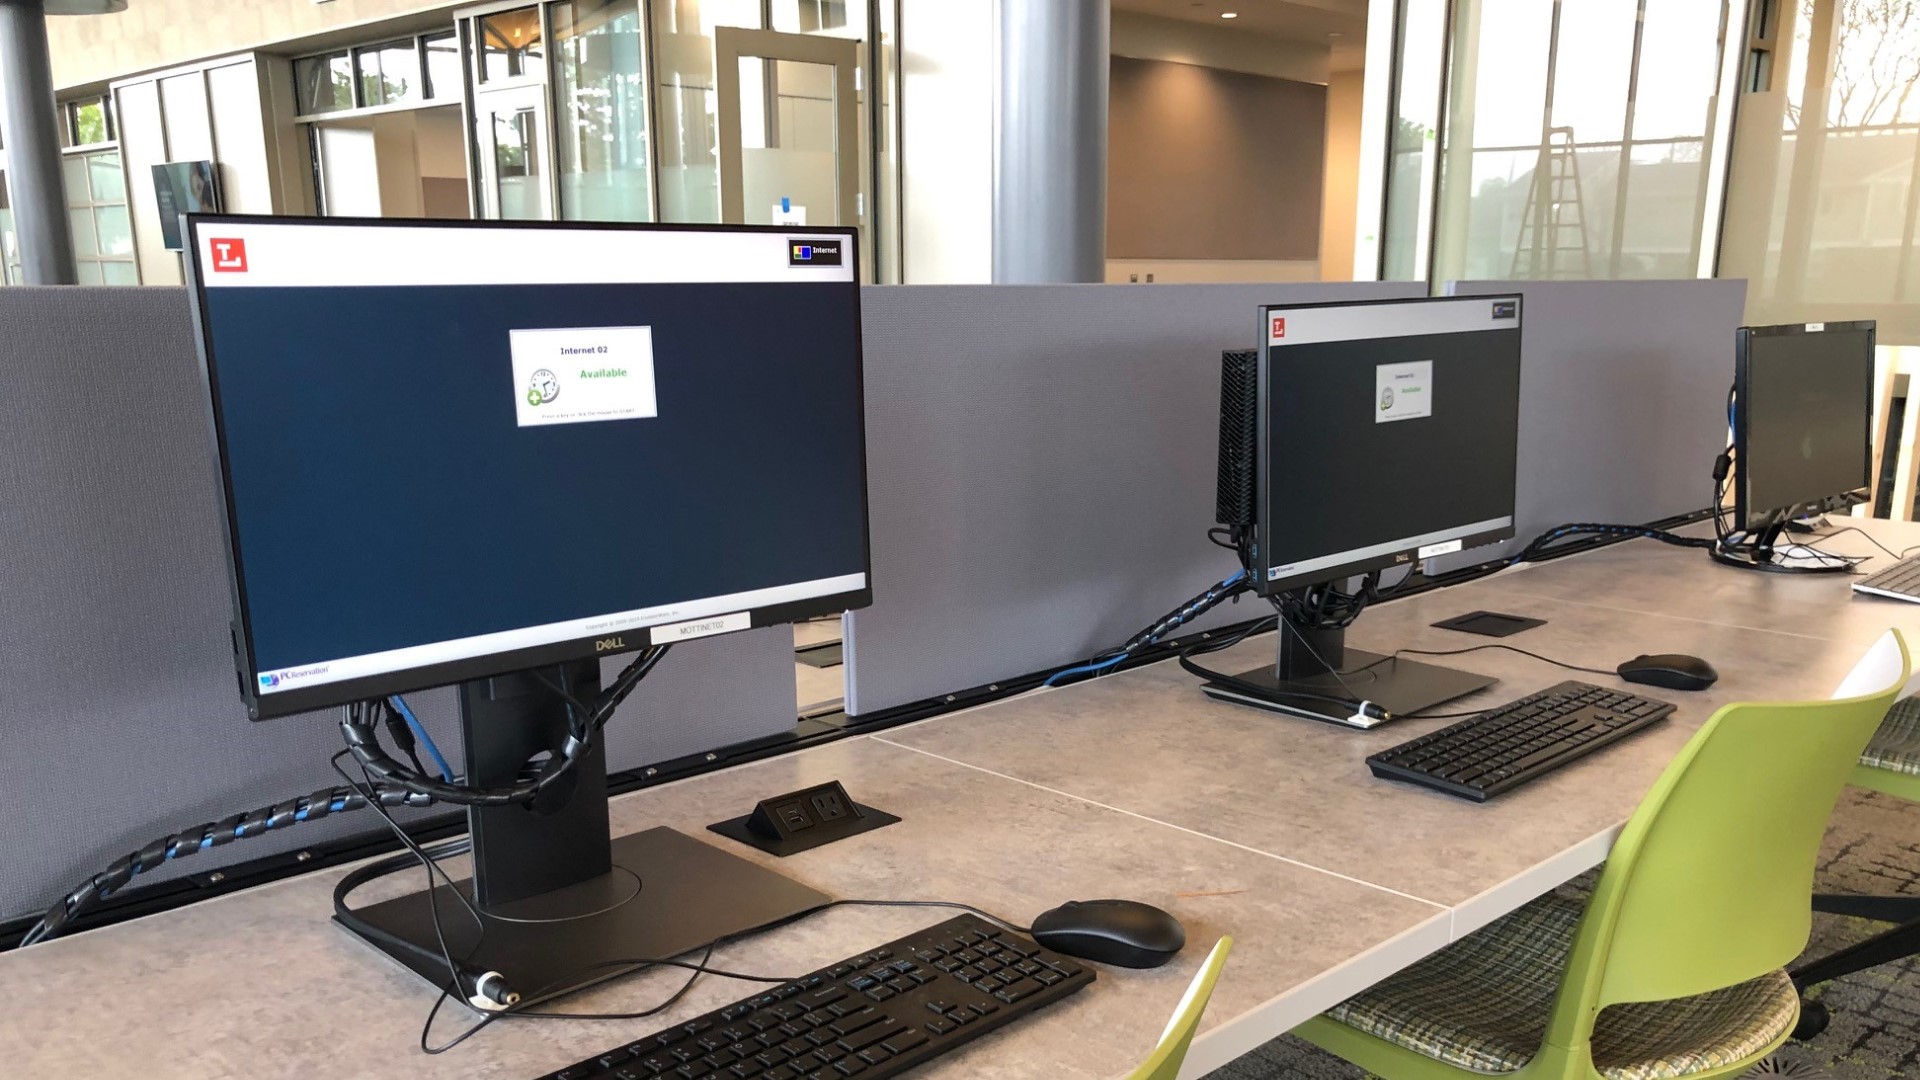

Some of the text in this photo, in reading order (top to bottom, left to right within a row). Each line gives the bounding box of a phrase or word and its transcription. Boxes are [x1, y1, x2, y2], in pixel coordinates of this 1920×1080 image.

[812, 246, 838, 254] Internet
[560, 345, 608, 355] Internet 02
[580, 368, 627, 379] Available
[595, 637, 625, 652] DELL
